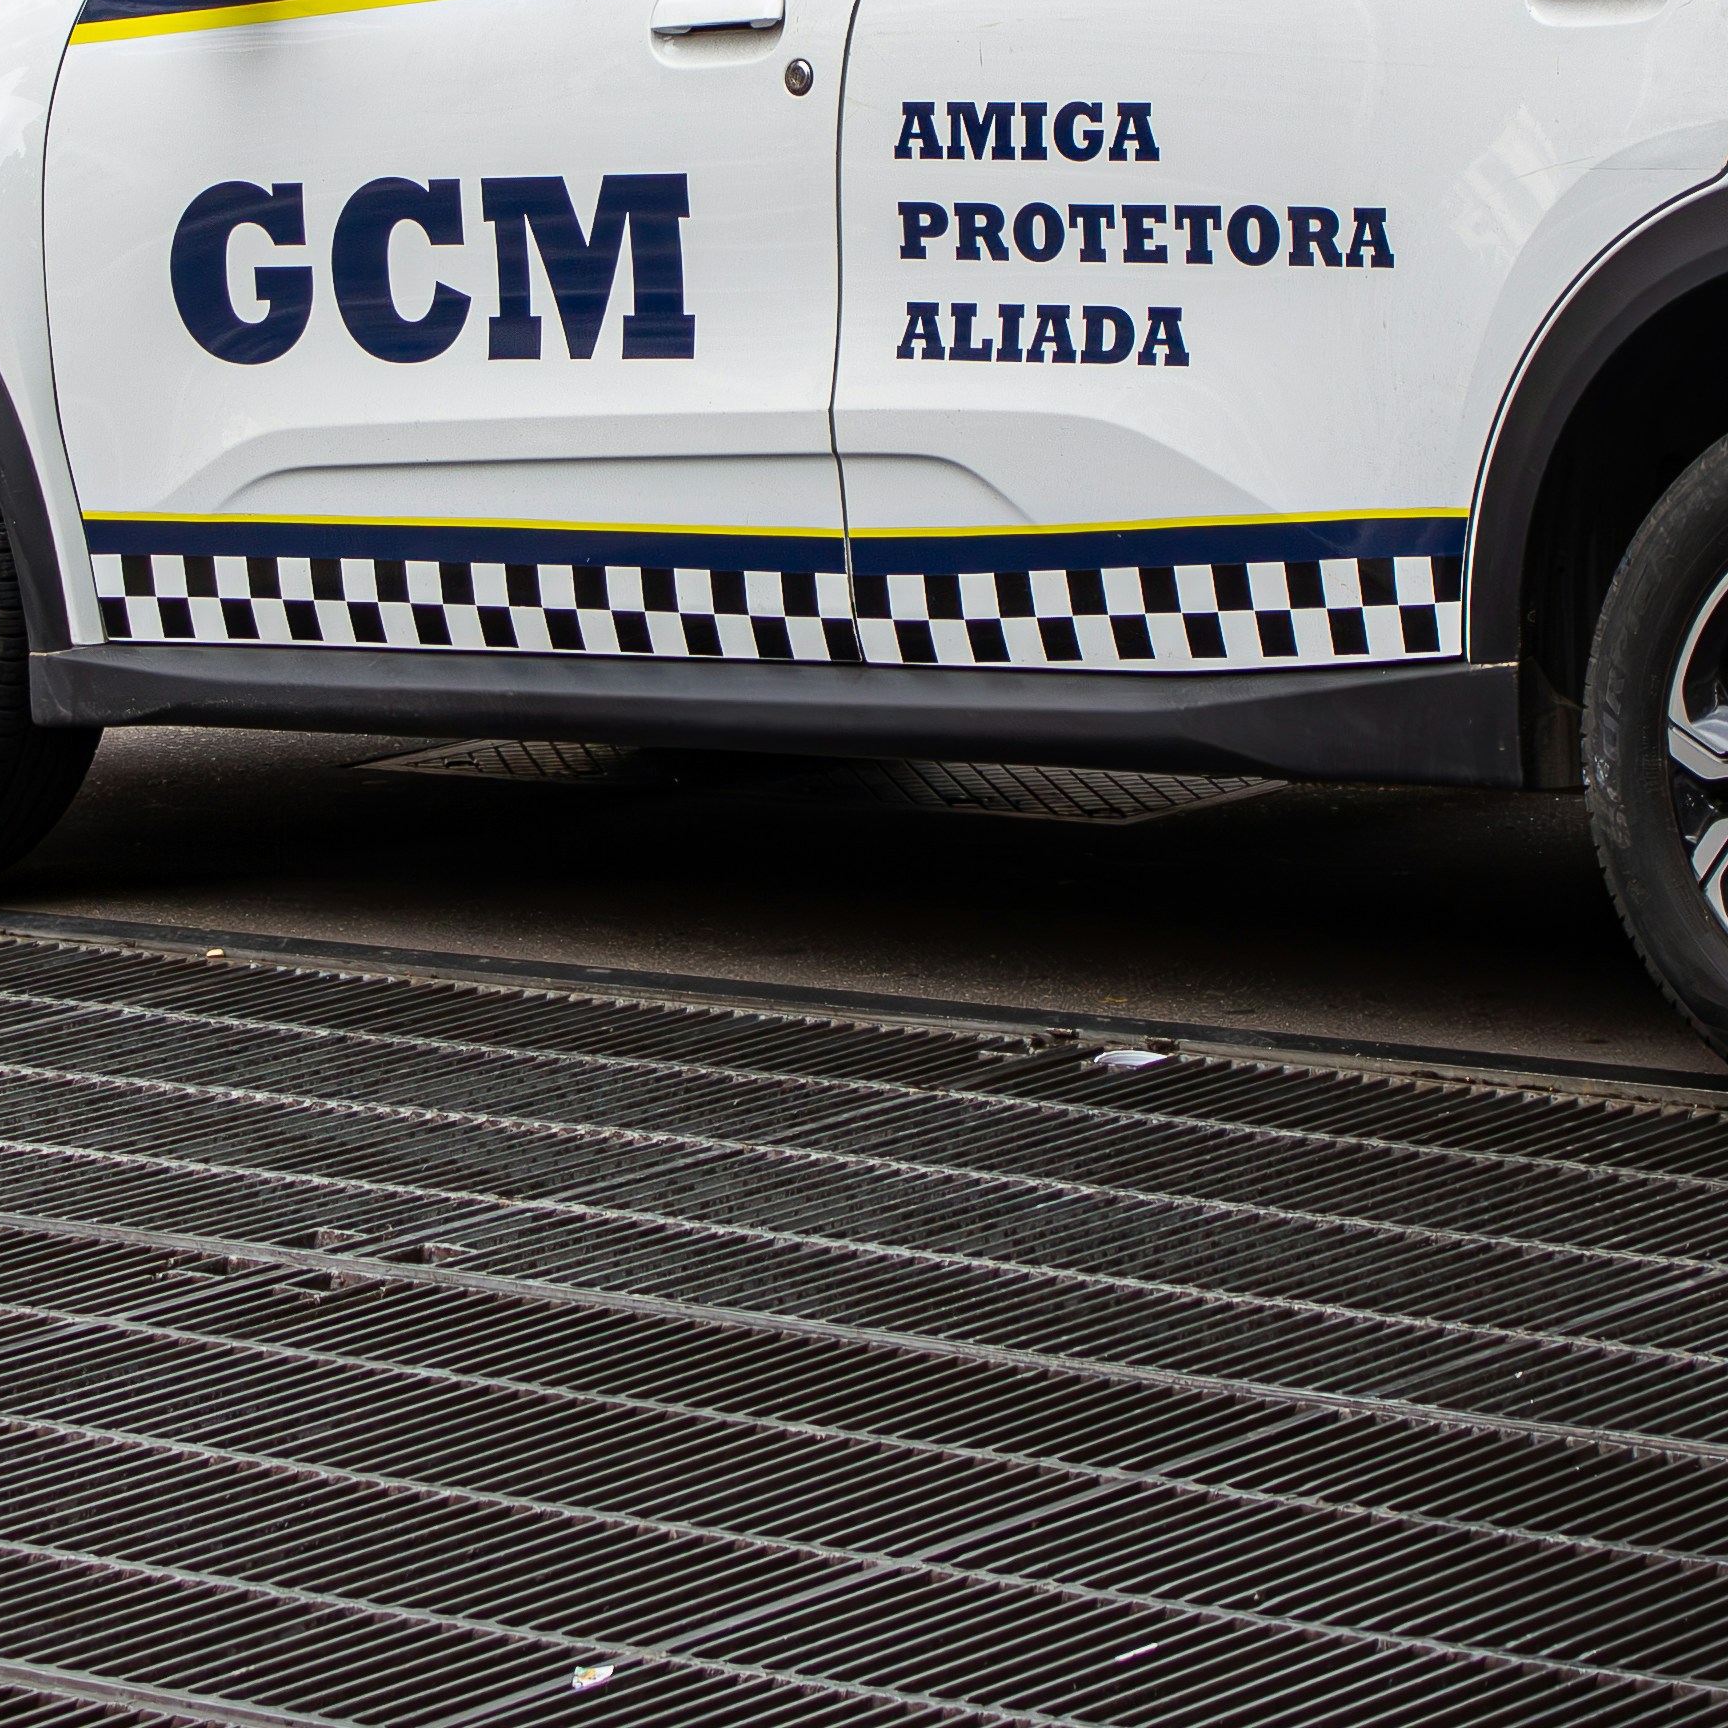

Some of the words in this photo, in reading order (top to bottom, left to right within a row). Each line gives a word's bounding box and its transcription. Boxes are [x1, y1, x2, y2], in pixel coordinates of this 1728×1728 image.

[894, 101, 1160, 162] AMIGA
[897, 202, 1395, 269] PROTETORA
[170, 173, 696, 365] GCM
[896, 301, 1190, 367] ALIADA
